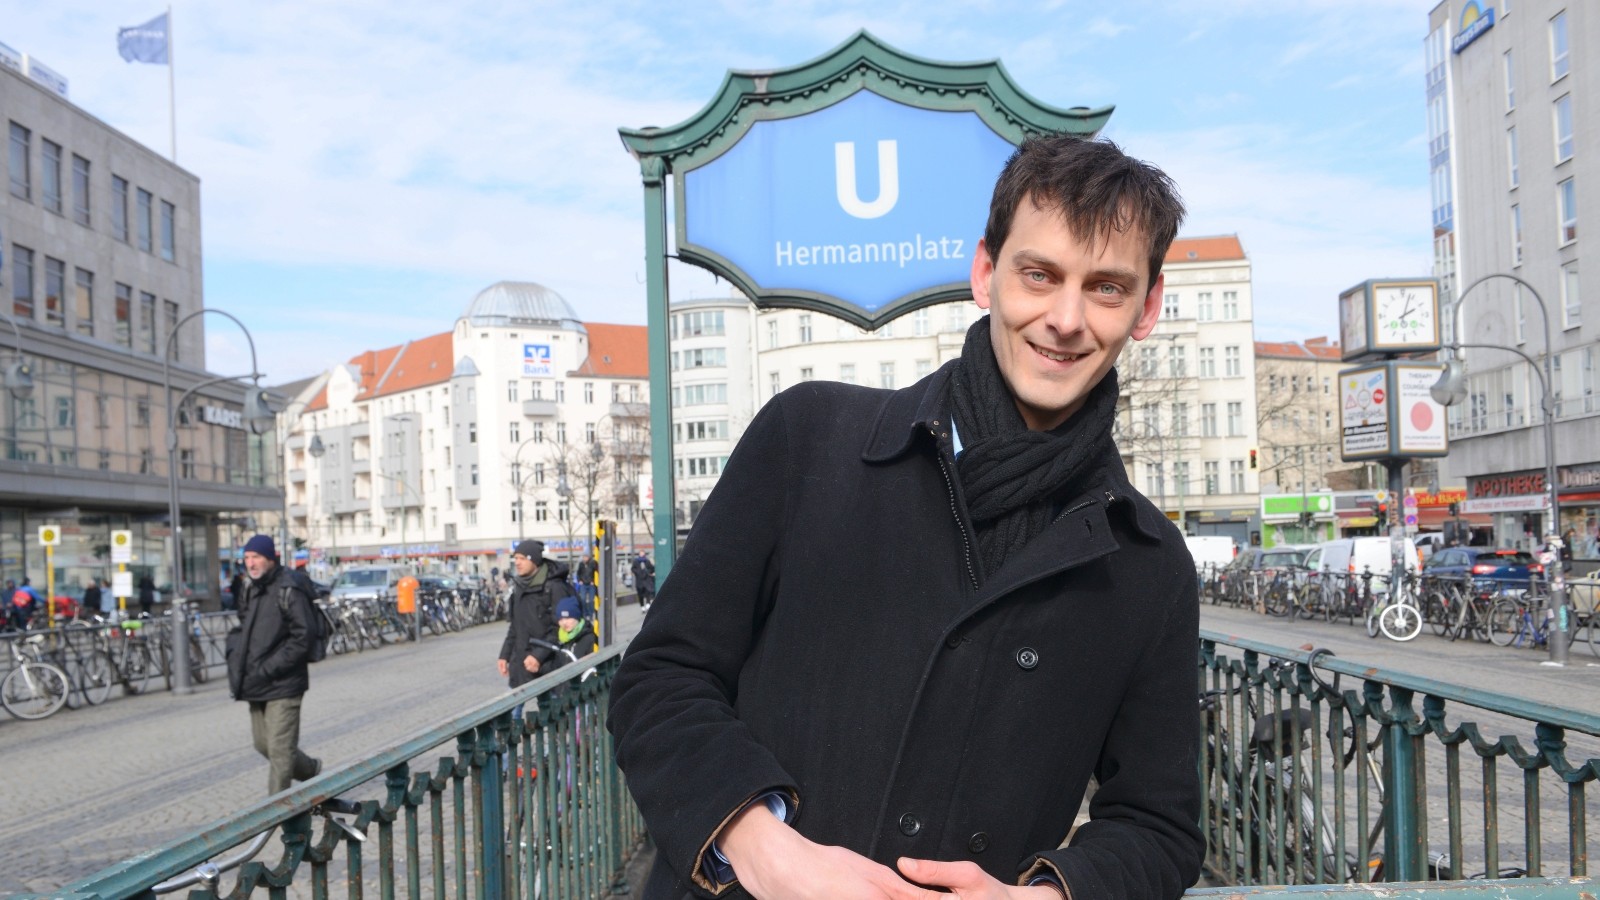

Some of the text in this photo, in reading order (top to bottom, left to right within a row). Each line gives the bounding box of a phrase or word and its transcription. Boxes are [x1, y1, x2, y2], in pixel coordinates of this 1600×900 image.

[835, 140, 899, 219] U
[776, 233, 965, 268] Hermannplatz
[524, 364, 551, 374] Bank
[205, 406, 242, 428] KARST
[1474, 474, 1545, 497] APOTHEKE
